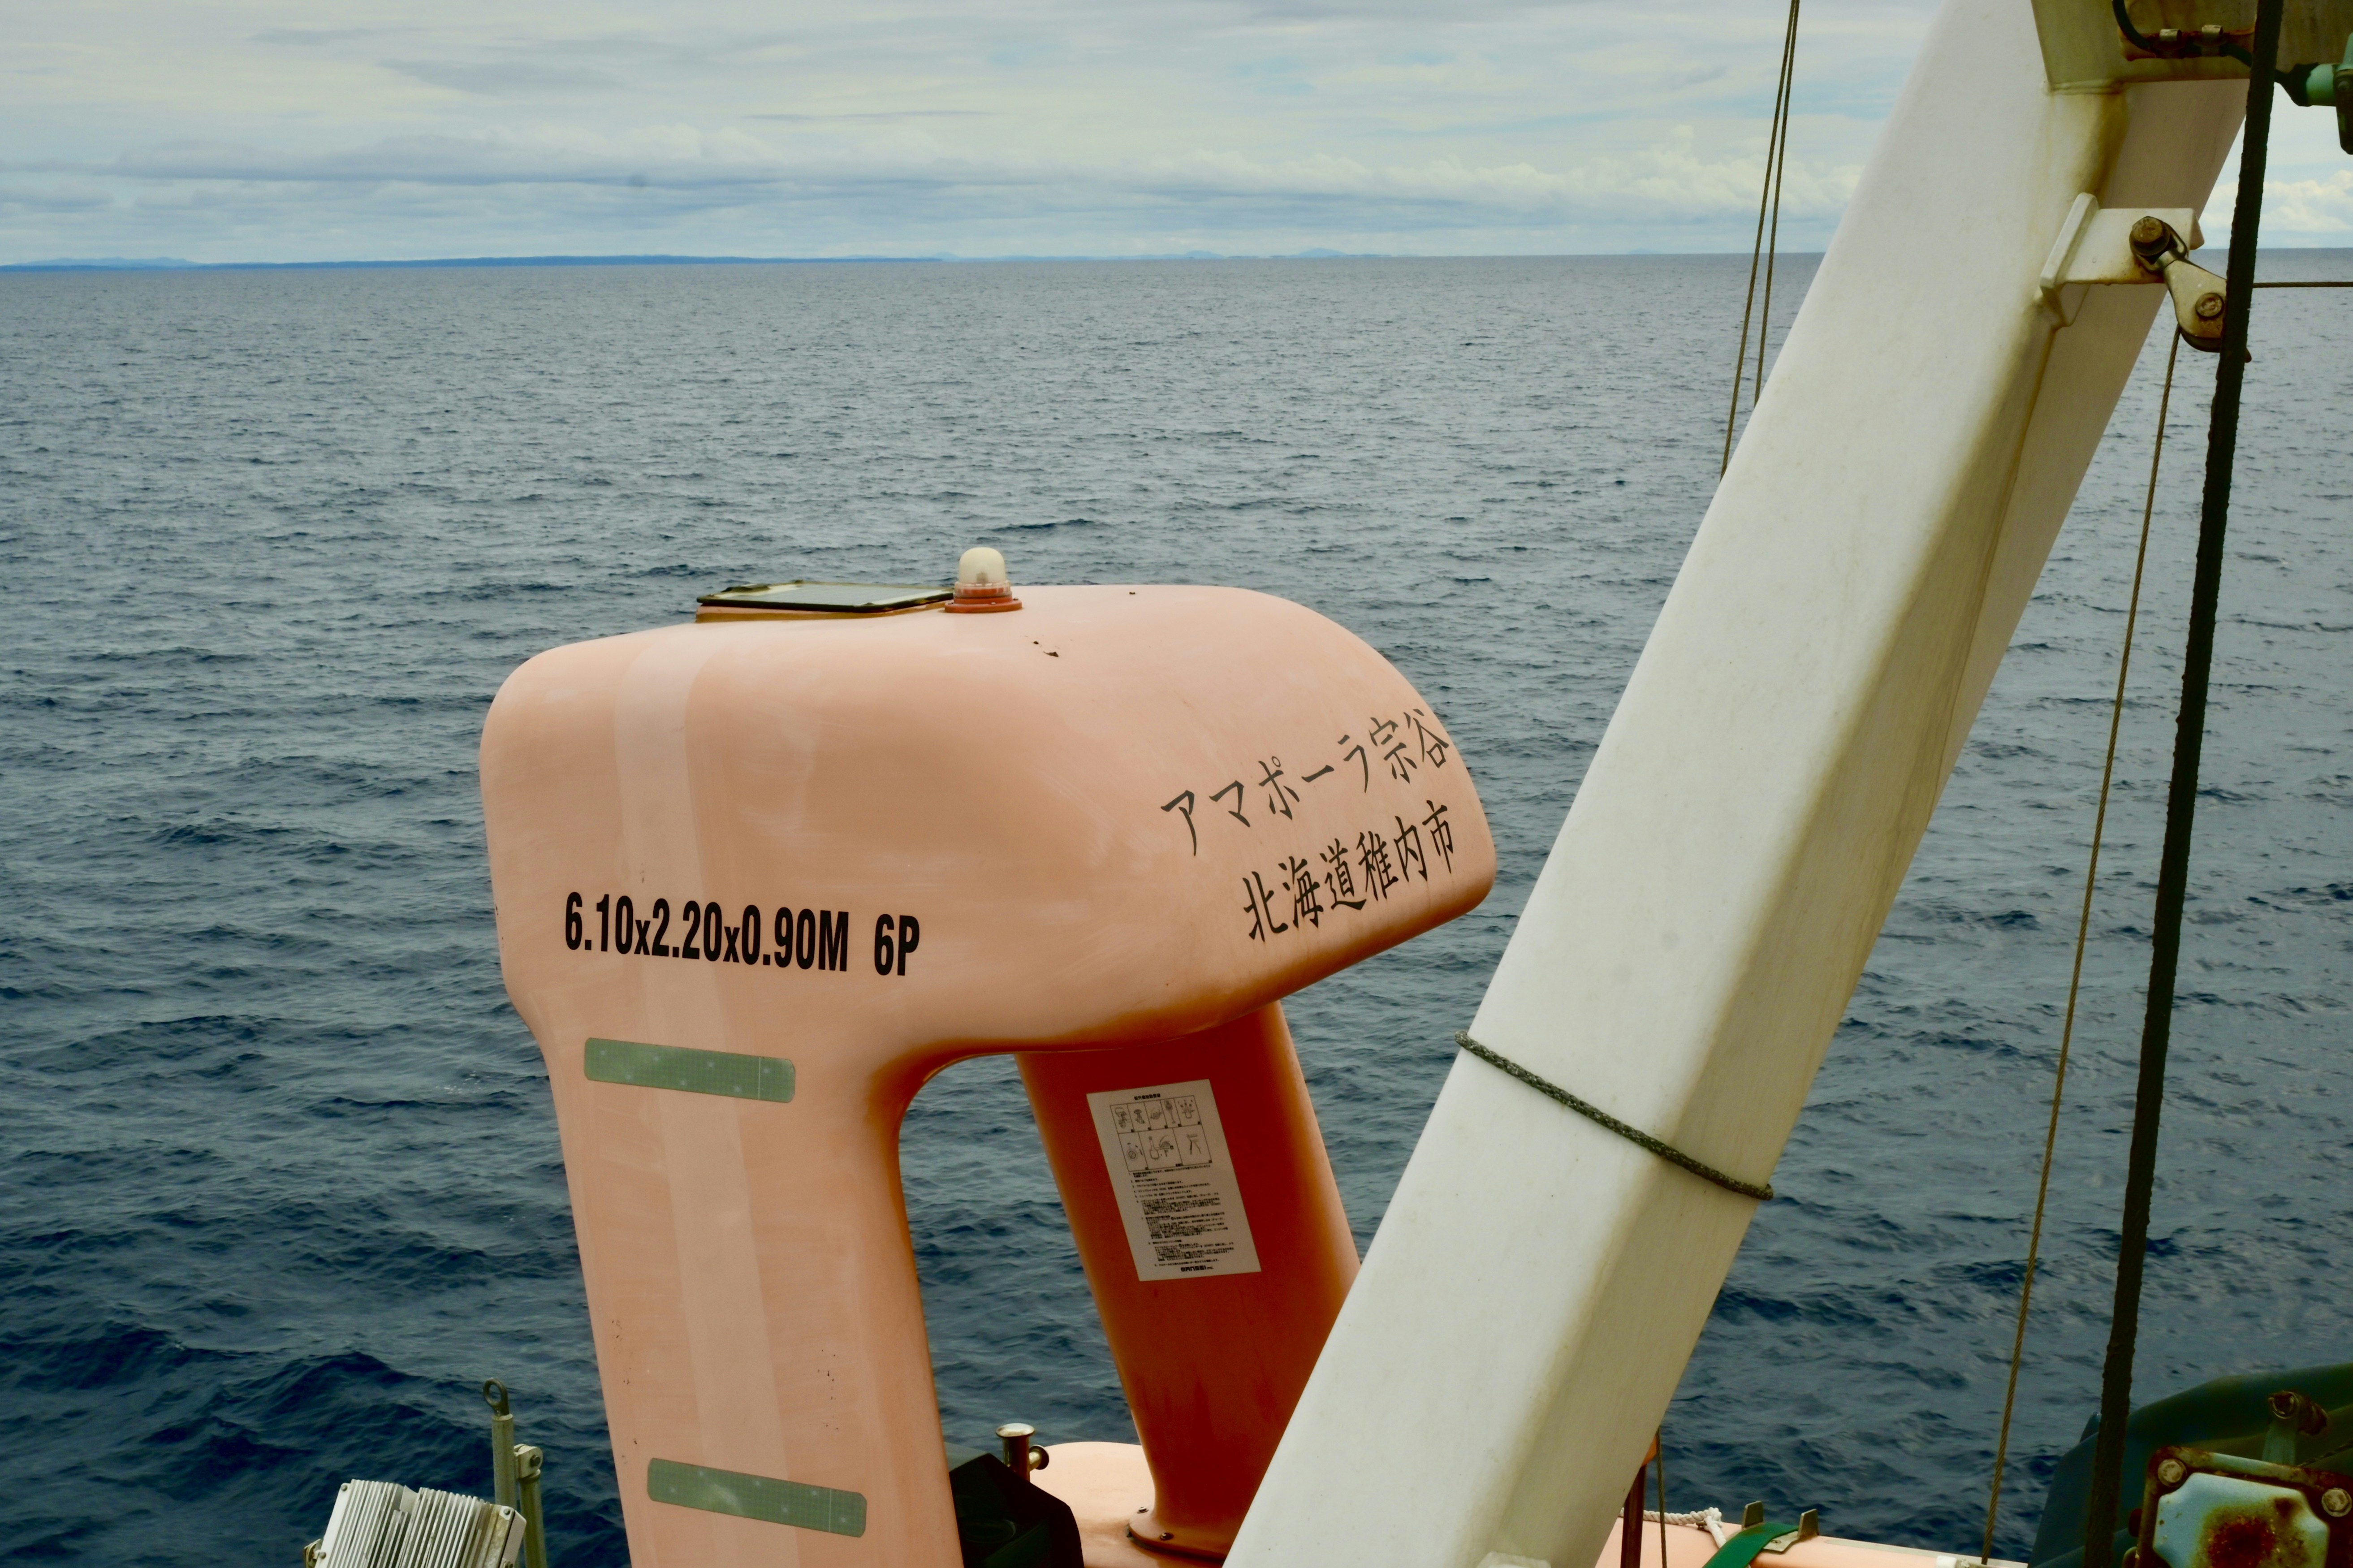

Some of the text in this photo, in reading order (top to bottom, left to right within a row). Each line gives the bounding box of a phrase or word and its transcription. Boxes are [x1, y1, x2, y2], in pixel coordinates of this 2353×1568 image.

[1161, 708, 1449, 856] アマポーラ宗谷
[566, 892, 920, 976] 6.10x2.20x0.90M 6P
[1243, 800, 1453, 942] 北海道稚内市
